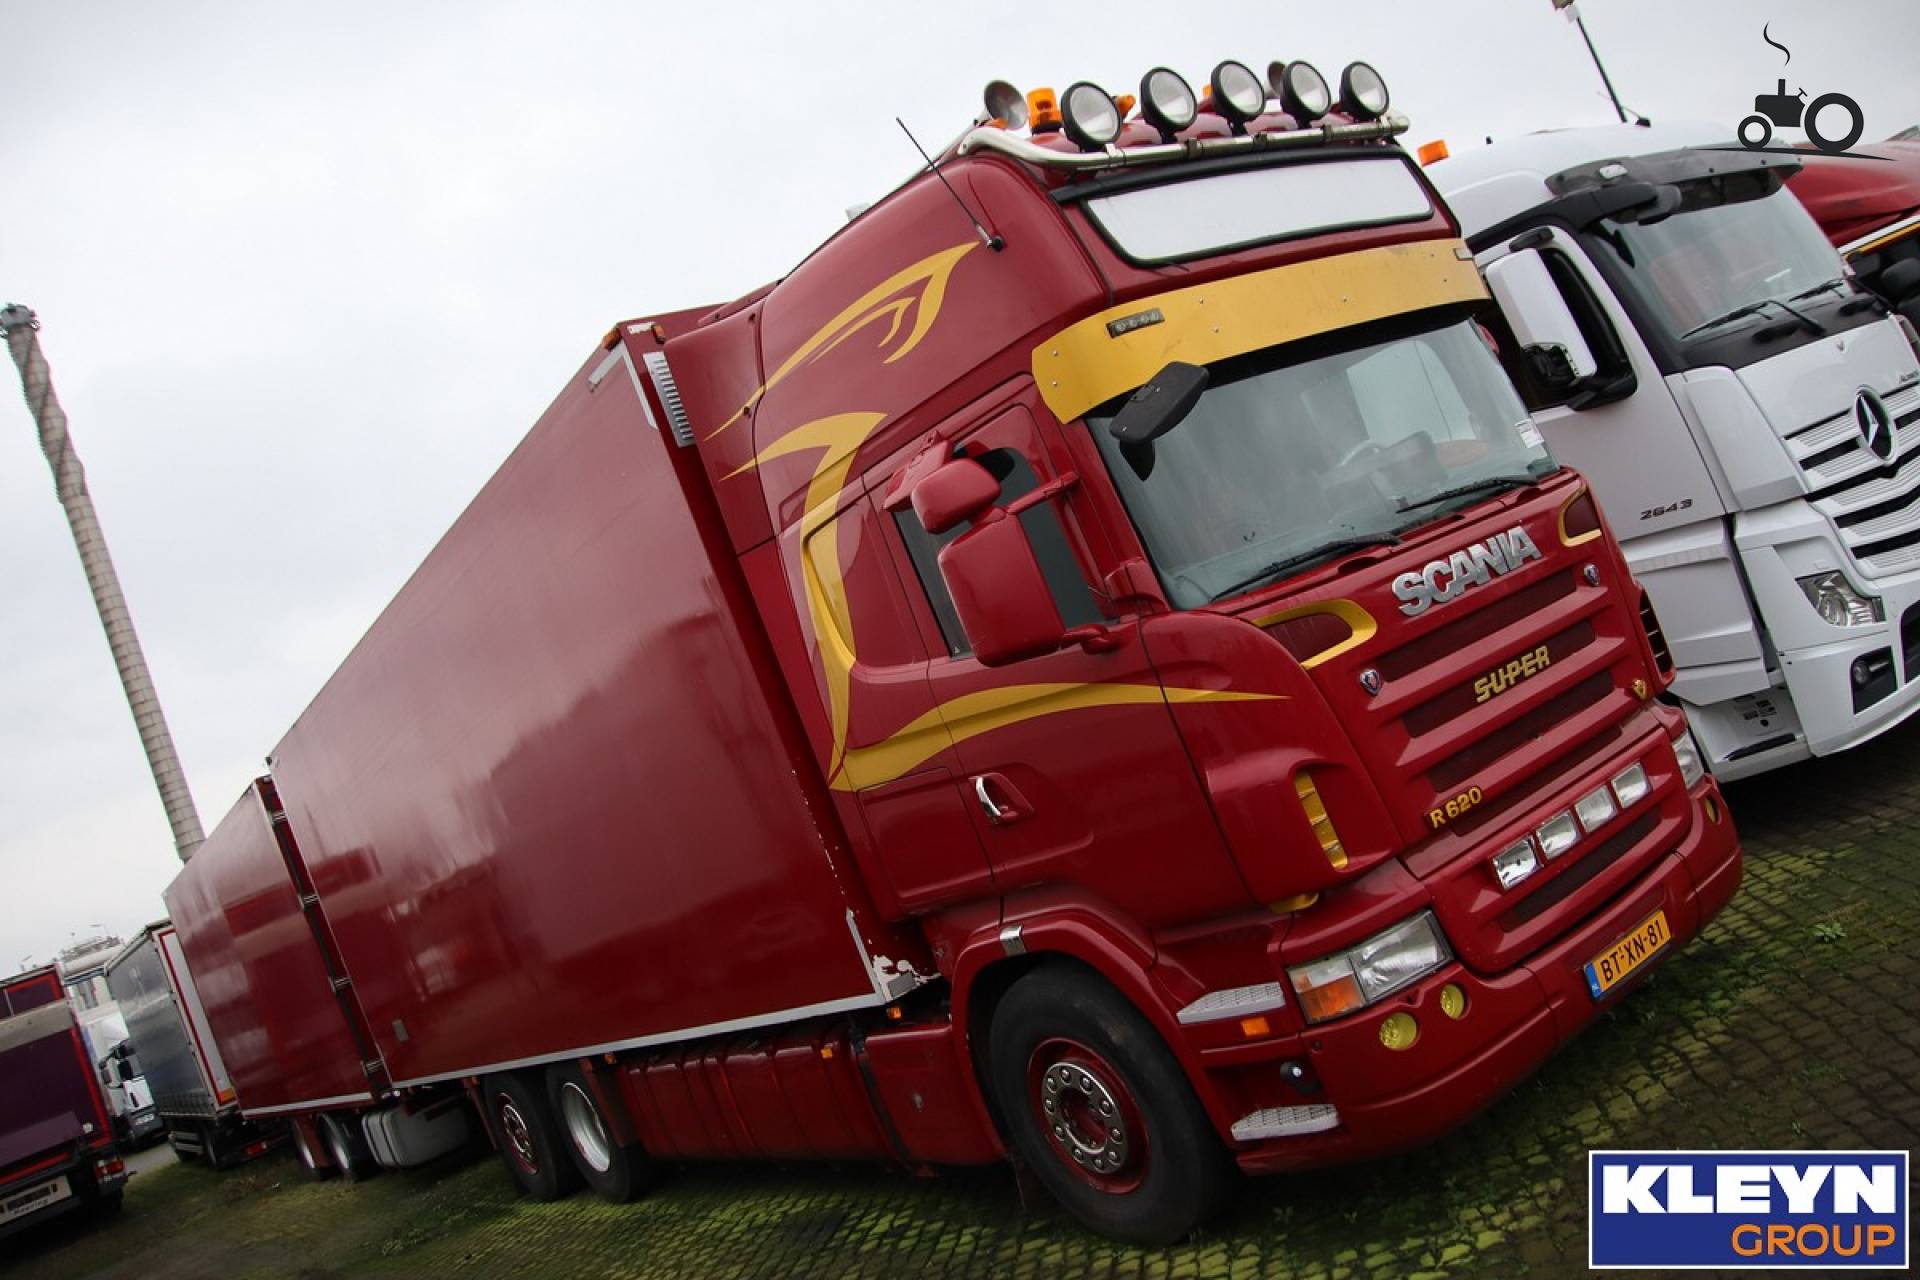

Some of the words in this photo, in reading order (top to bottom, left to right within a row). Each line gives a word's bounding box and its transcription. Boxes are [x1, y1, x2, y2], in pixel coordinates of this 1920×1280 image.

[1640, 498, 1693, 520] 2643
[1391, 525, 1542, 617] SCANIA
[1474, 645, 1550, 703] SUPER
[1430, 808, 1446, 829] R
[1446, 786, 1482, 818] 620
[1601, 919, 1664, 982] BT-XN-81
